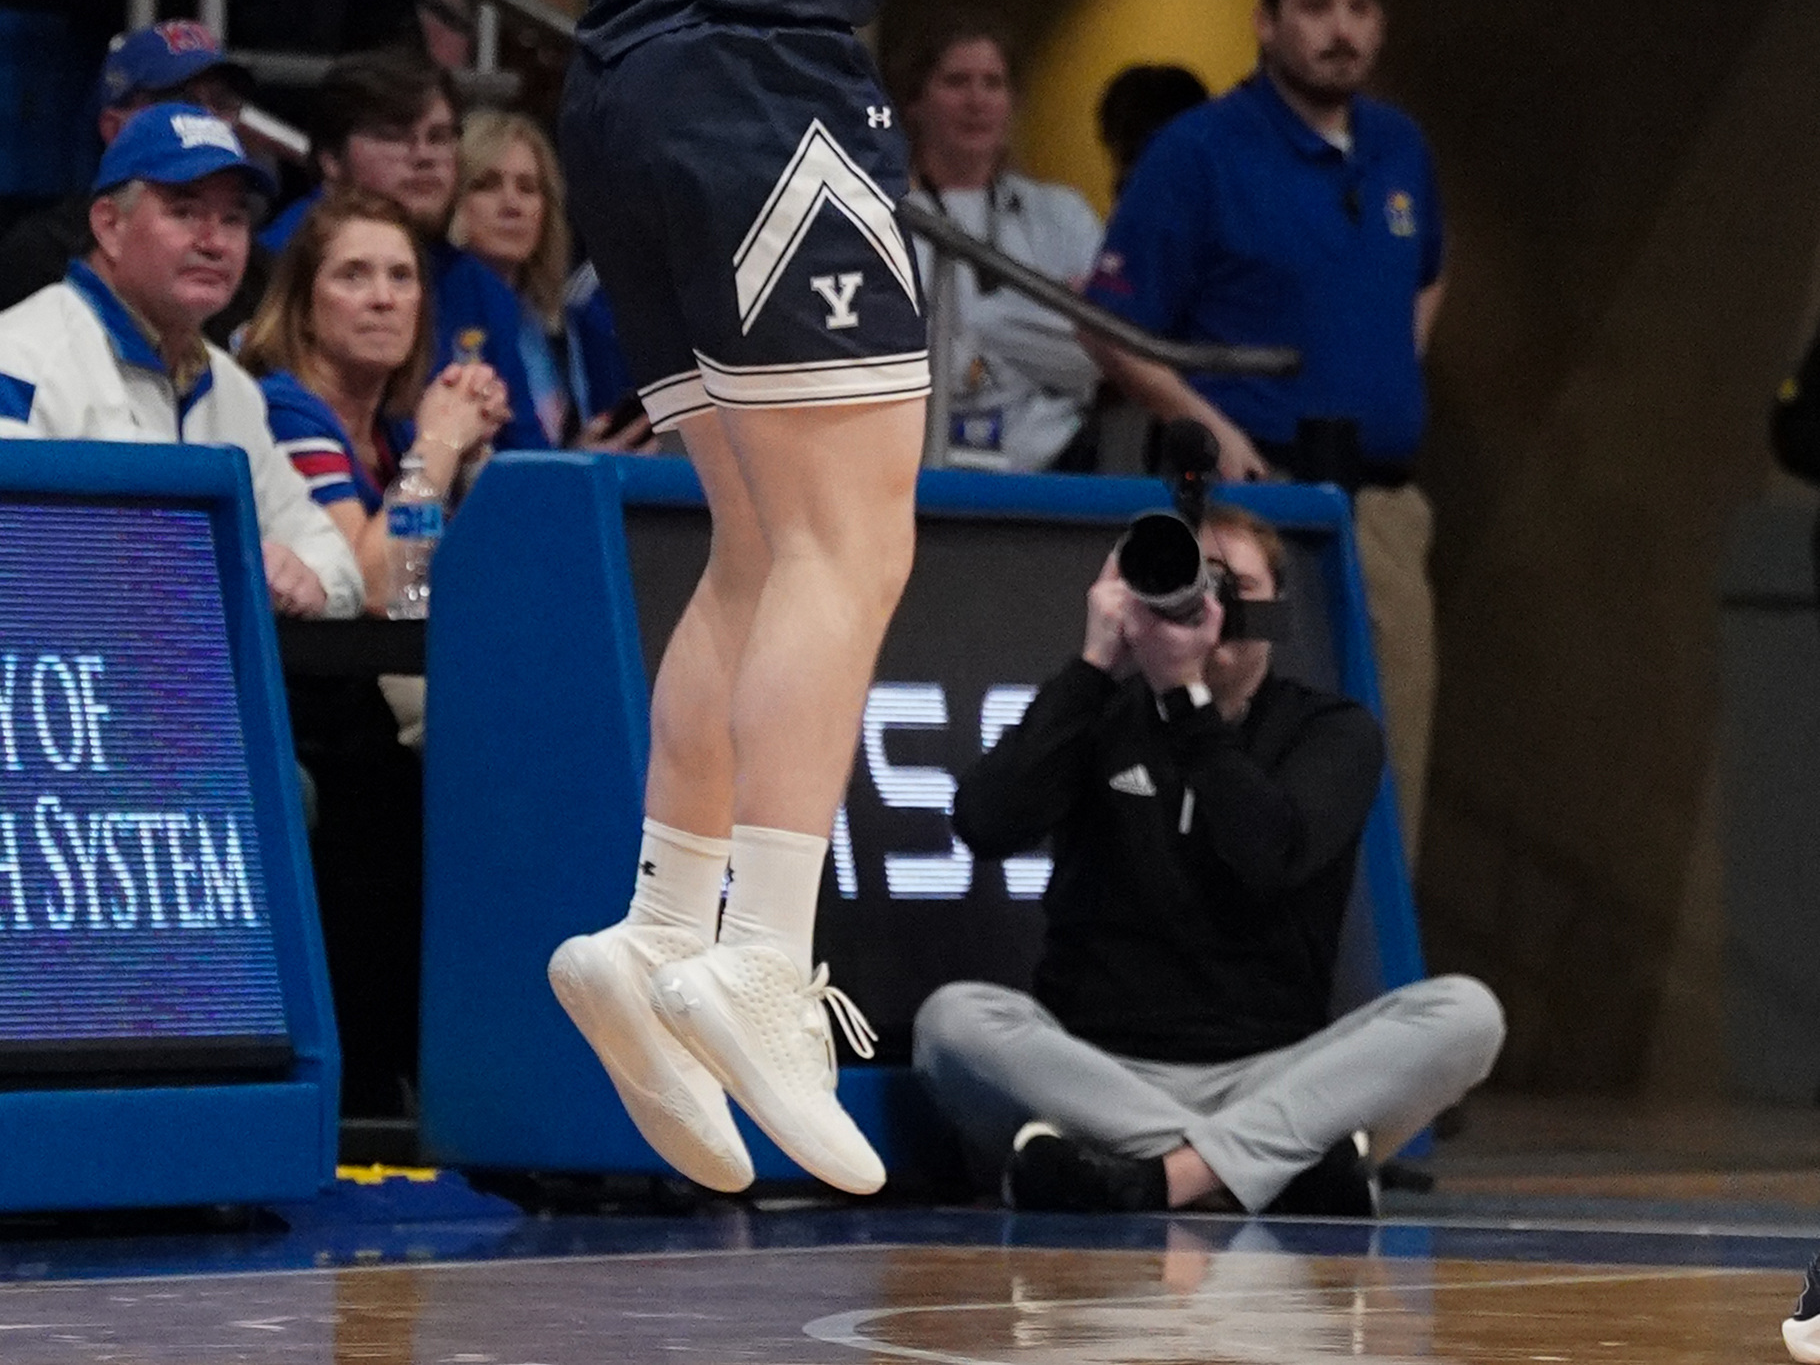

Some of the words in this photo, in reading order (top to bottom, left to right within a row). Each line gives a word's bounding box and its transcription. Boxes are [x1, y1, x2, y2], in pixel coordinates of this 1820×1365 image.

[809, 270, 864, 331] Y
[31, 654, 110, 772] OF
[34, 795, 262, 930] SYSTEM
